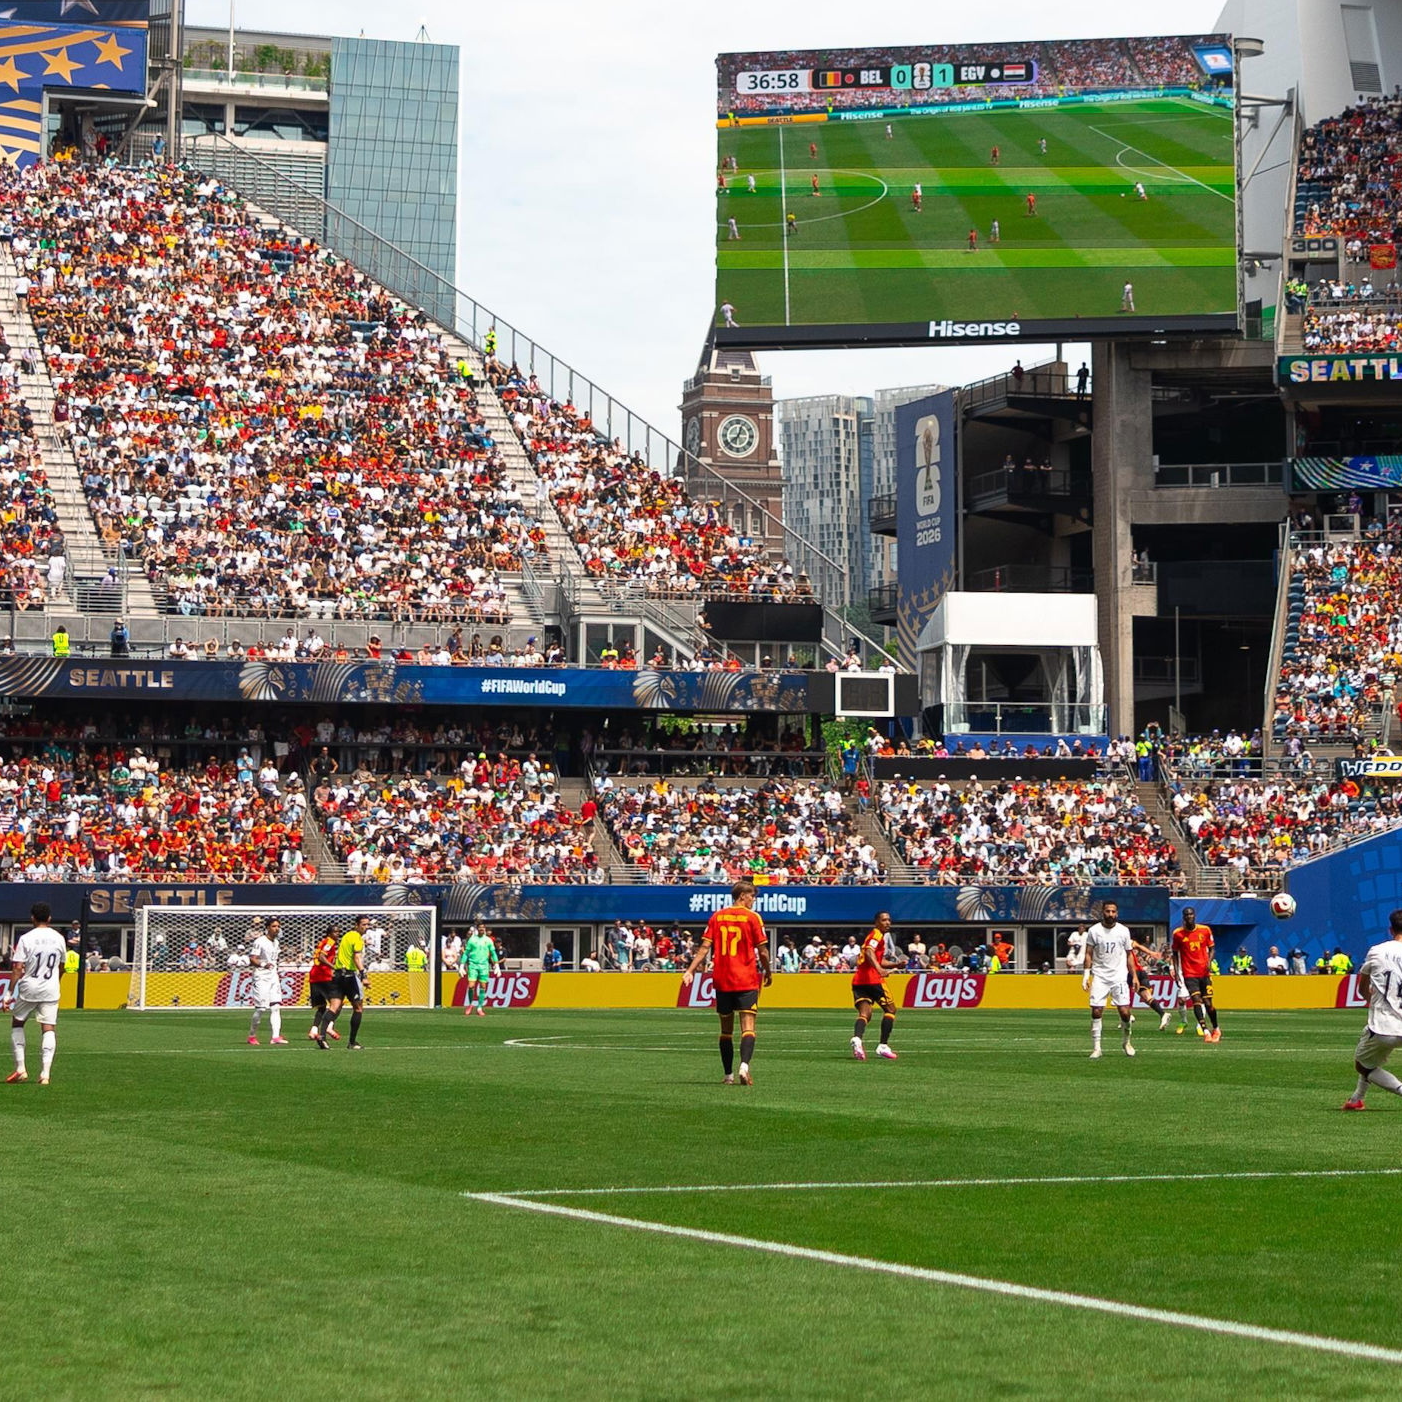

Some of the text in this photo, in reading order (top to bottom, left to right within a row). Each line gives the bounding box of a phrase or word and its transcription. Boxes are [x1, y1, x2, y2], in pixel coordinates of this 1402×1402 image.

[747, 73, 799, 89] 36:58
[860, 70, 883, 85] BEL
[1019, 98, 1059, 109] Hisense
[767, 116, 793, 124] SEATTLE
[841, 110, 884, 121] Hisense
[1292, 238, 1337, 252] 300
[929, 320, 1020, 337] Hisense
[923, 494, 935, 506] FIFA
[916, 528, 941, 547] 2026
[69, 668, 174, 687] SEATTLE
[481, 679, 566, 696] #FIFAWorldCup
[720, 925, 742, 957] 17
[1105, 941, 1117, 954] 17
[1189, 941, 1201, 952] 24
[31, 952, 57, 980] 19
[914, 973, 977, 1008] Lay's
